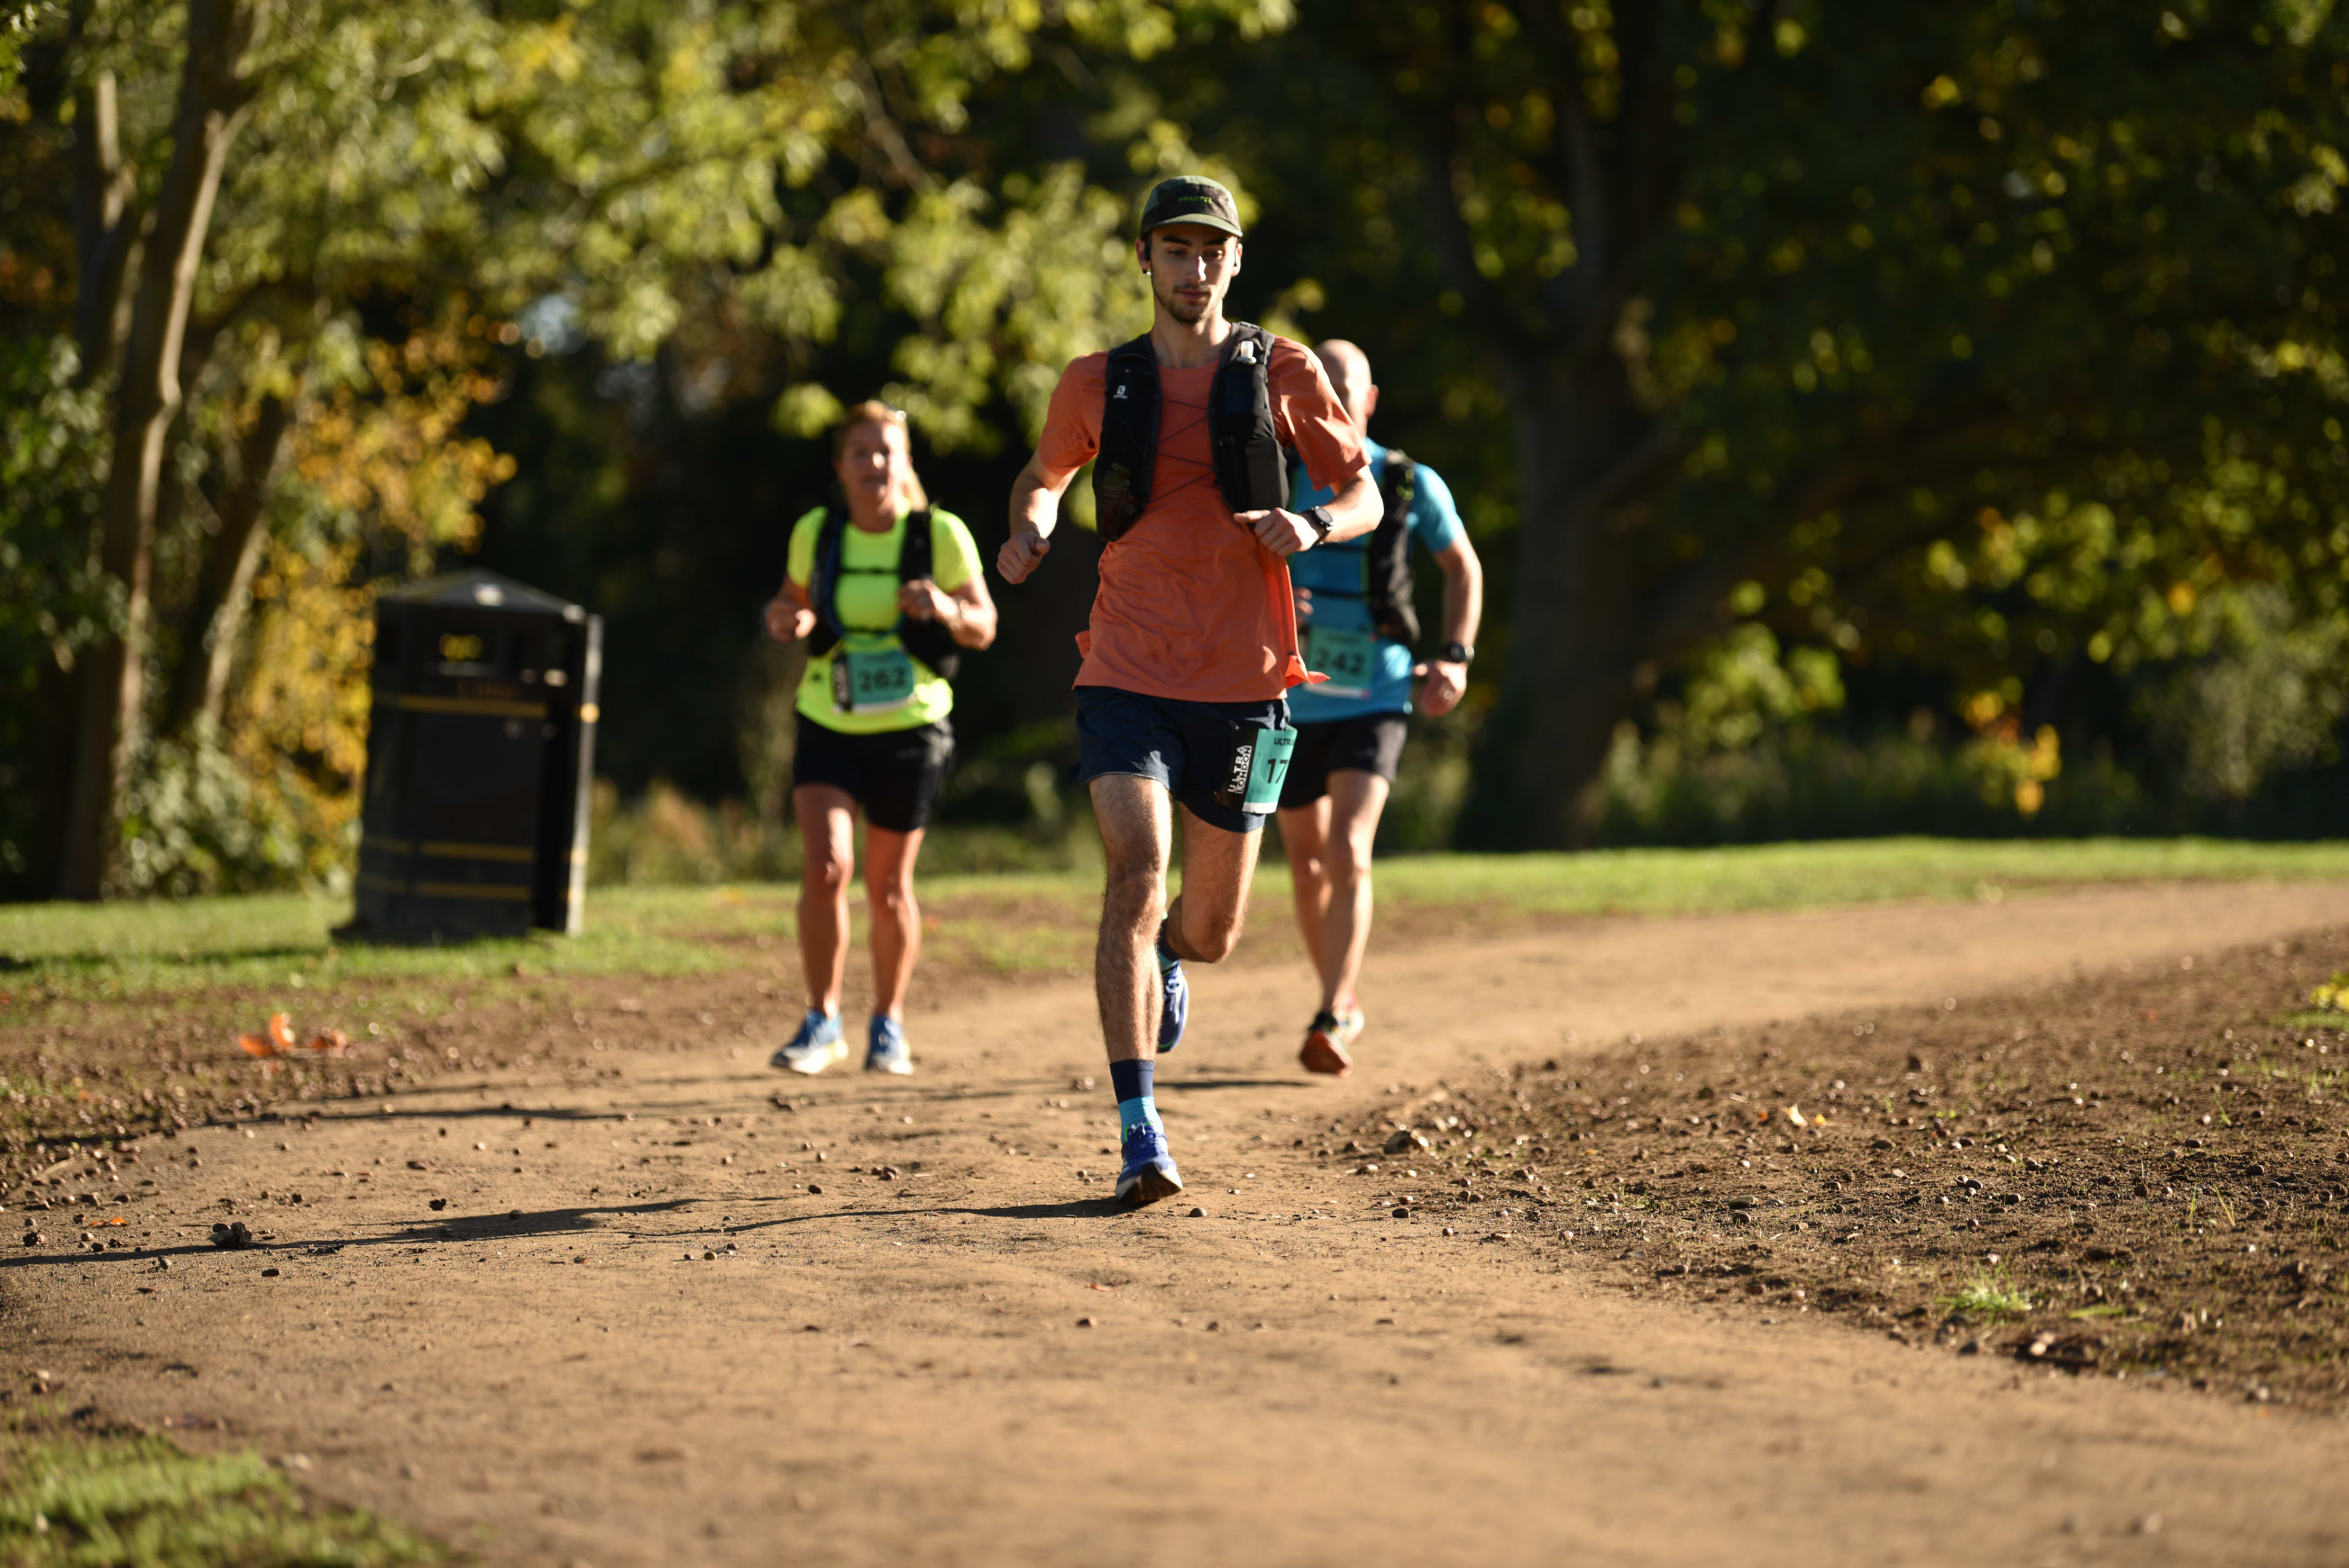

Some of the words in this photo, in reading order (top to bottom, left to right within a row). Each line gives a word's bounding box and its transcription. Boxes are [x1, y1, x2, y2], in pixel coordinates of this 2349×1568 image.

[1316, 647, 1365, 675] 242
[859, 667, 906, 692] 262
[1228, 746, 1244, 792] ULTRA
[1236, 746, 1252, 793] LONDON
[1267, 759, 1288, 784] 17
